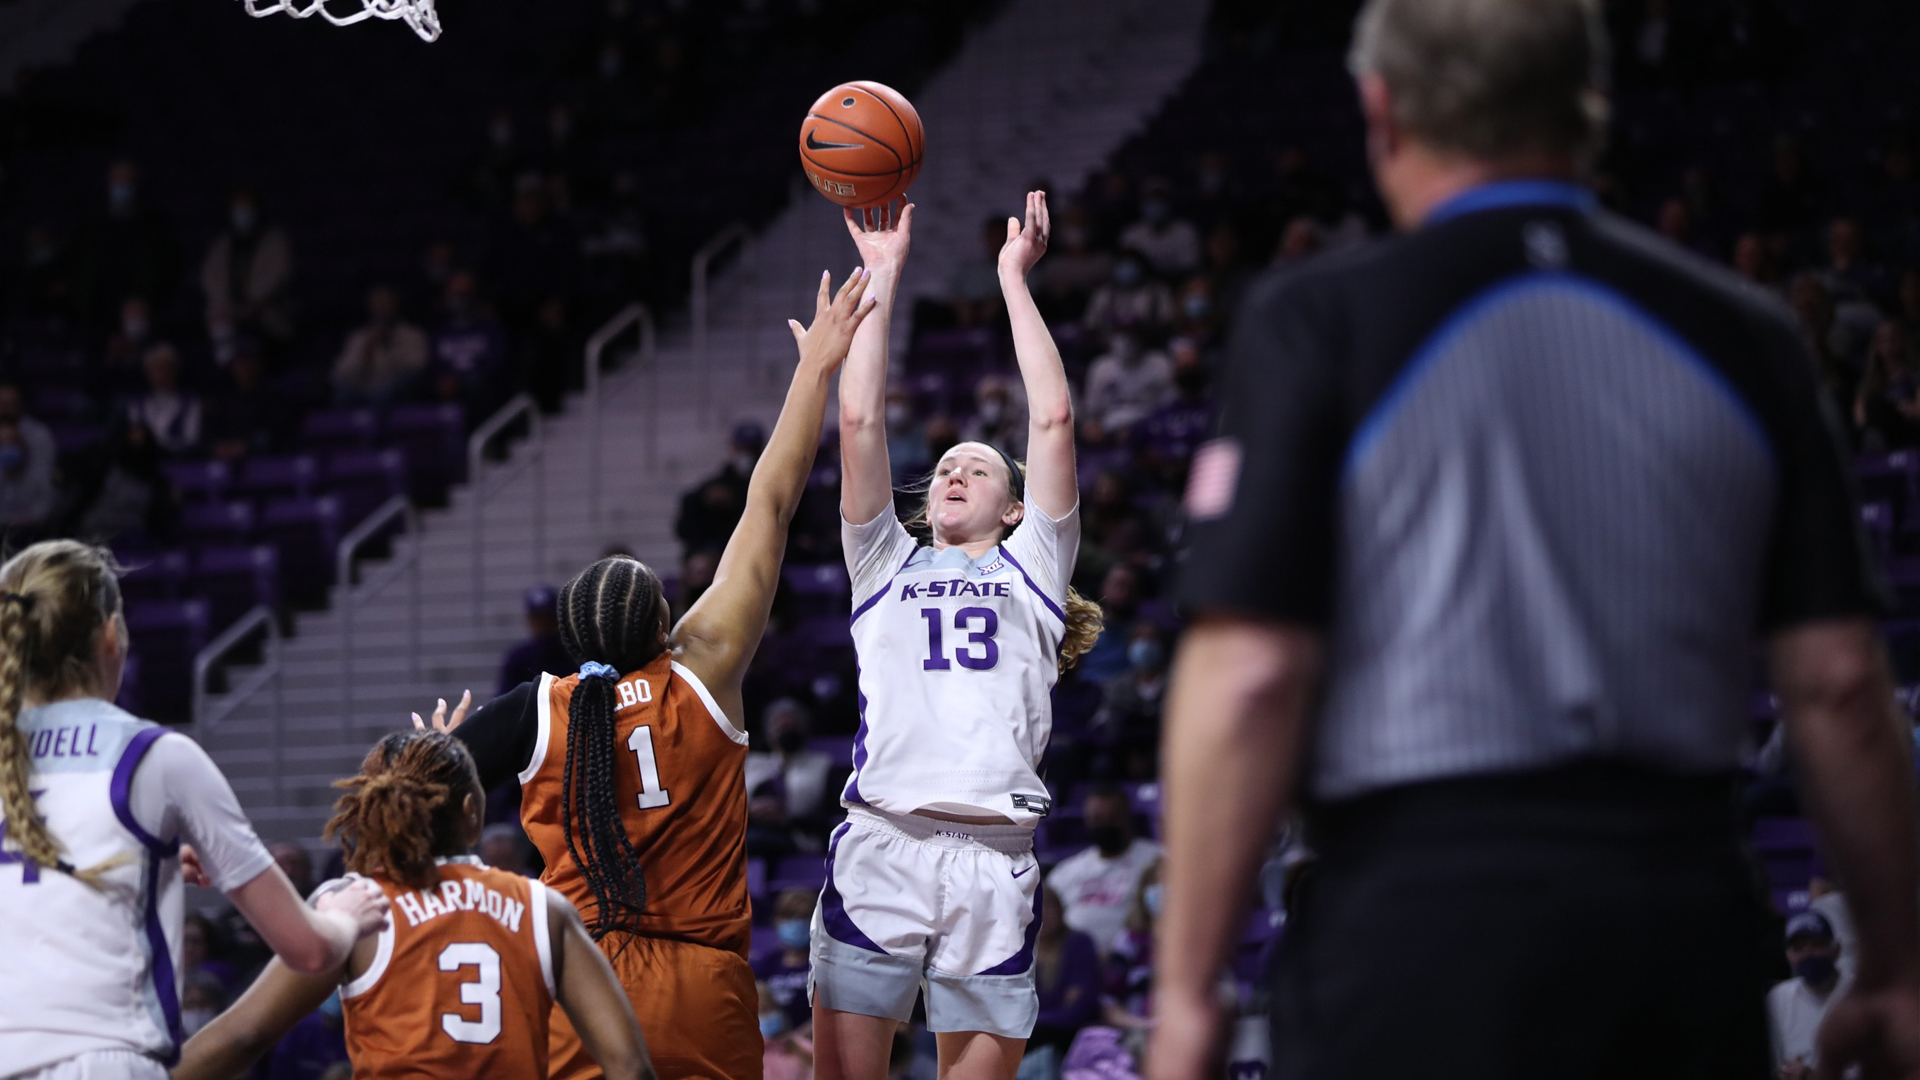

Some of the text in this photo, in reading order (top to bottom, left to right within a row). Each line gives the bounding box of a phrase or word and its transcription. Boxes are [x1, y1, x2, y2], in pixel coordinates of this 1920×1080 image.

[901, 579, 1010, 602] K-STATE
[921, 607, 999, 671] 13
[613, 679, 652, 712] BO
[627, 724, 671, 811] 1
[935, 830, 971, 841] K-STATE
[395, 878, 525, 933] HARMON
[438, 942, 502, 1045] 3
